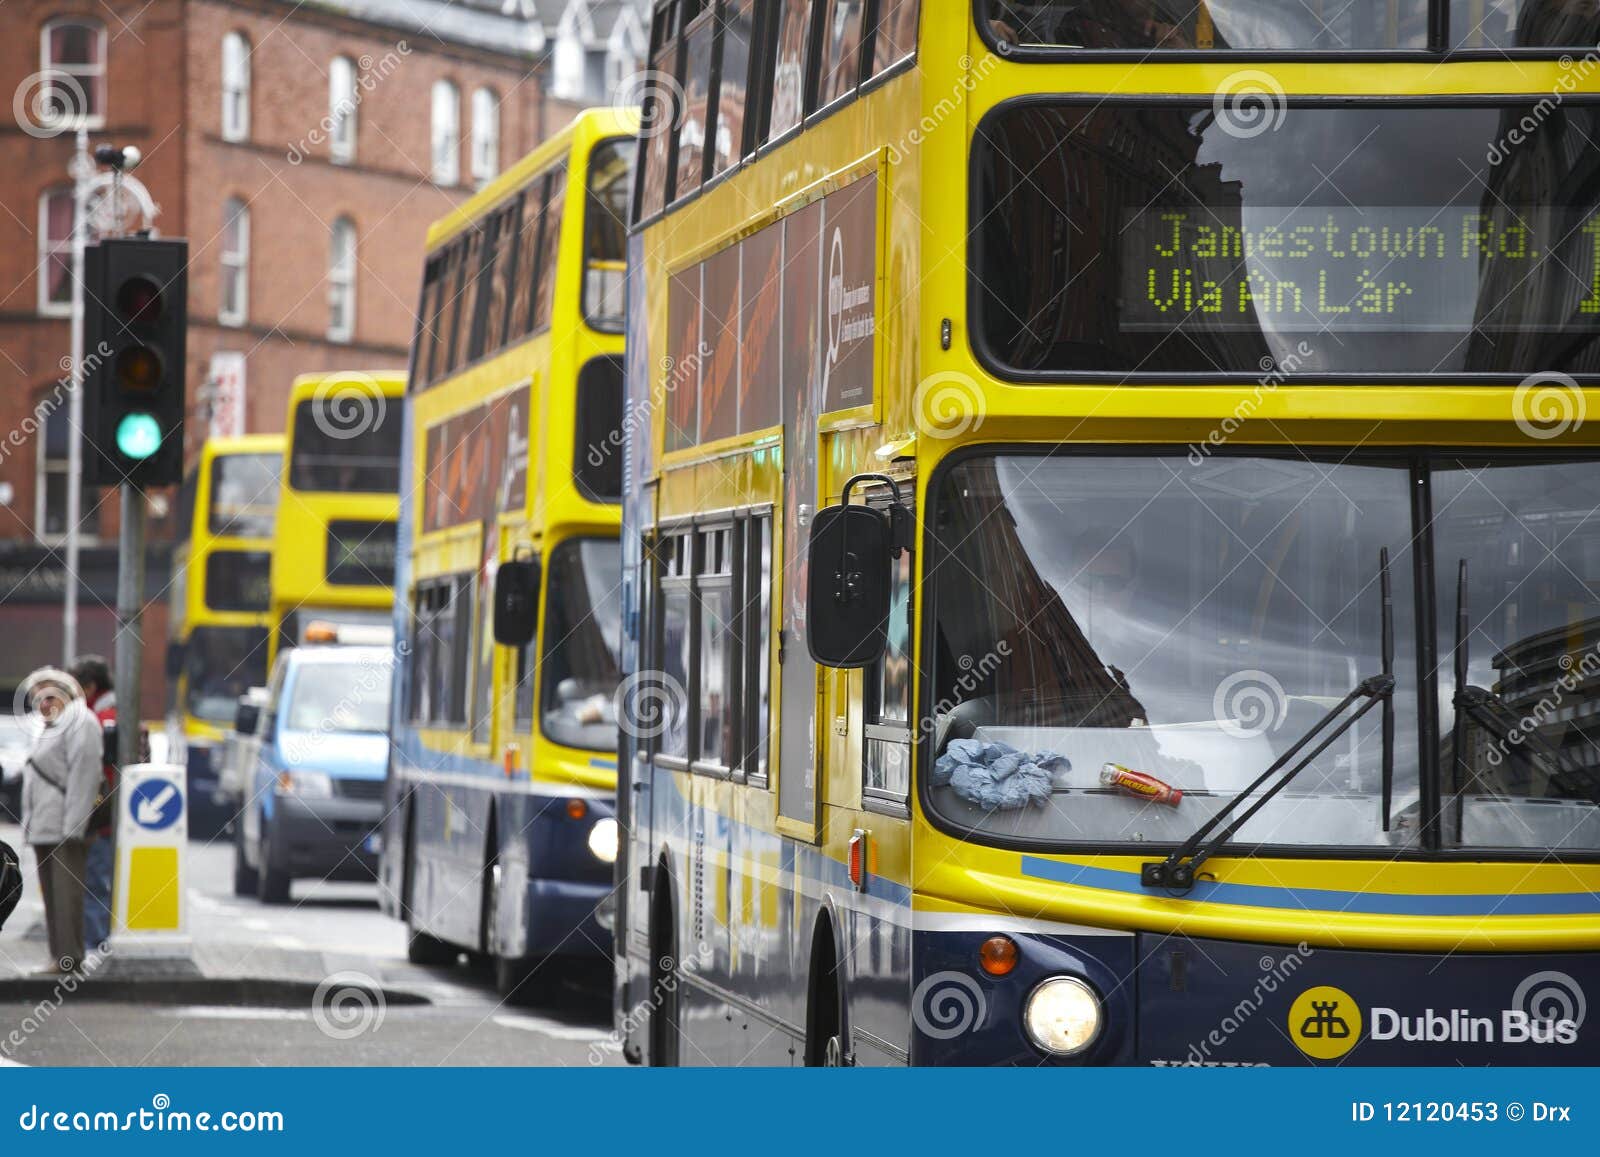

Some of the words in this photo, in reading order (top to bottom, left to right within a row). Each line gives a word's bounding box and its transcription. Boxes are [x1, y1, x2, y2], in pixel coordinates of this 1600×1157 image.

[1155, 213, 1445, 258] Jamestown
[1462, 213, 1539, 258] Rd.
[1148, 268, 1222, 313] Via
[1318, 268, 1413, 313] Lár
[1370, 1007, 1494, 1043] Dublin
[1502, 1009, 1578, 1045] Bus
